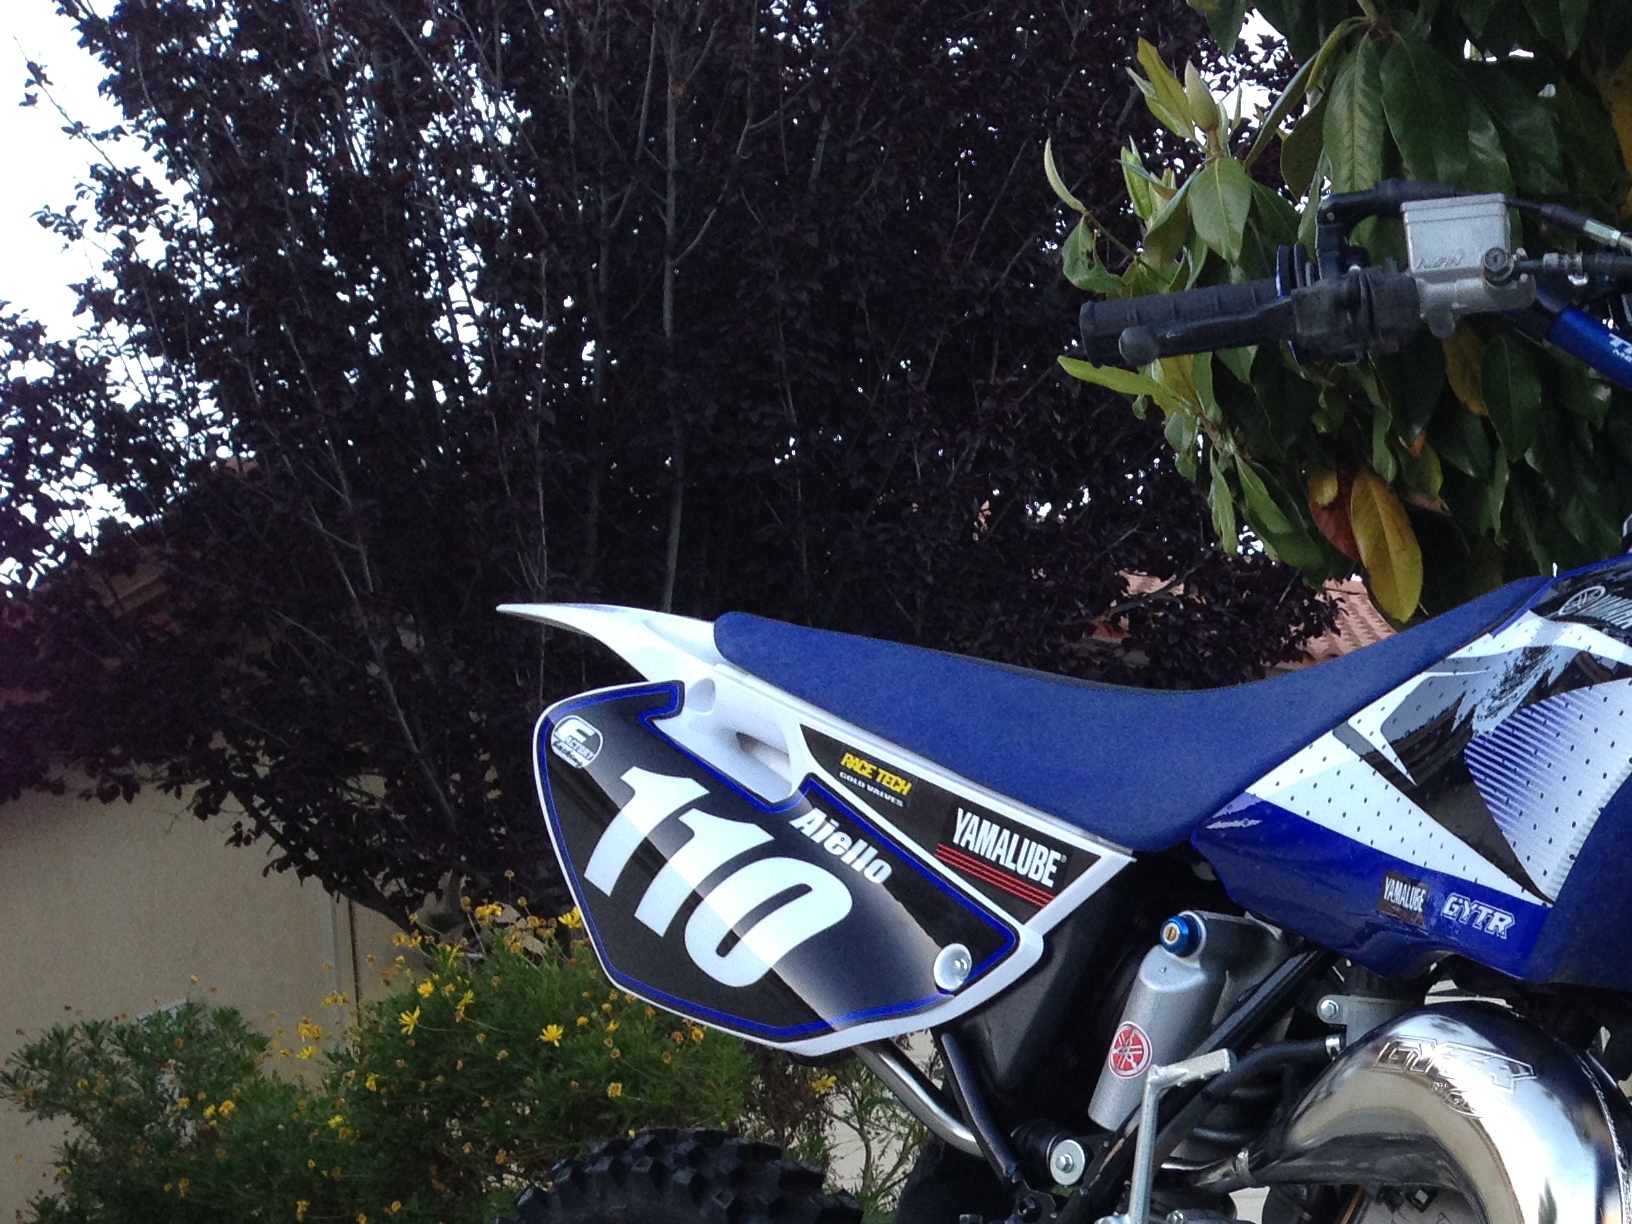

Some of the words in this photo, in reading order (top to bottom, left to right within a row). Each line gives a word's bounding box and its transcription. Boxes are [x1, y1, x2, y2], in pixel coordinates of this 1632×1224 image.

[840, 752, 878, 780] RACE
[875, 767, 913, 796] TECH
[584, 765, 853, 988] 110
[788, 807, 894, 884] Aiello
[952, 807, 1062, 888] YAMALUBE
[1383, 876, 1427, 913] YAMALUBE
[1440, 892, 1516, 940] GYTR
